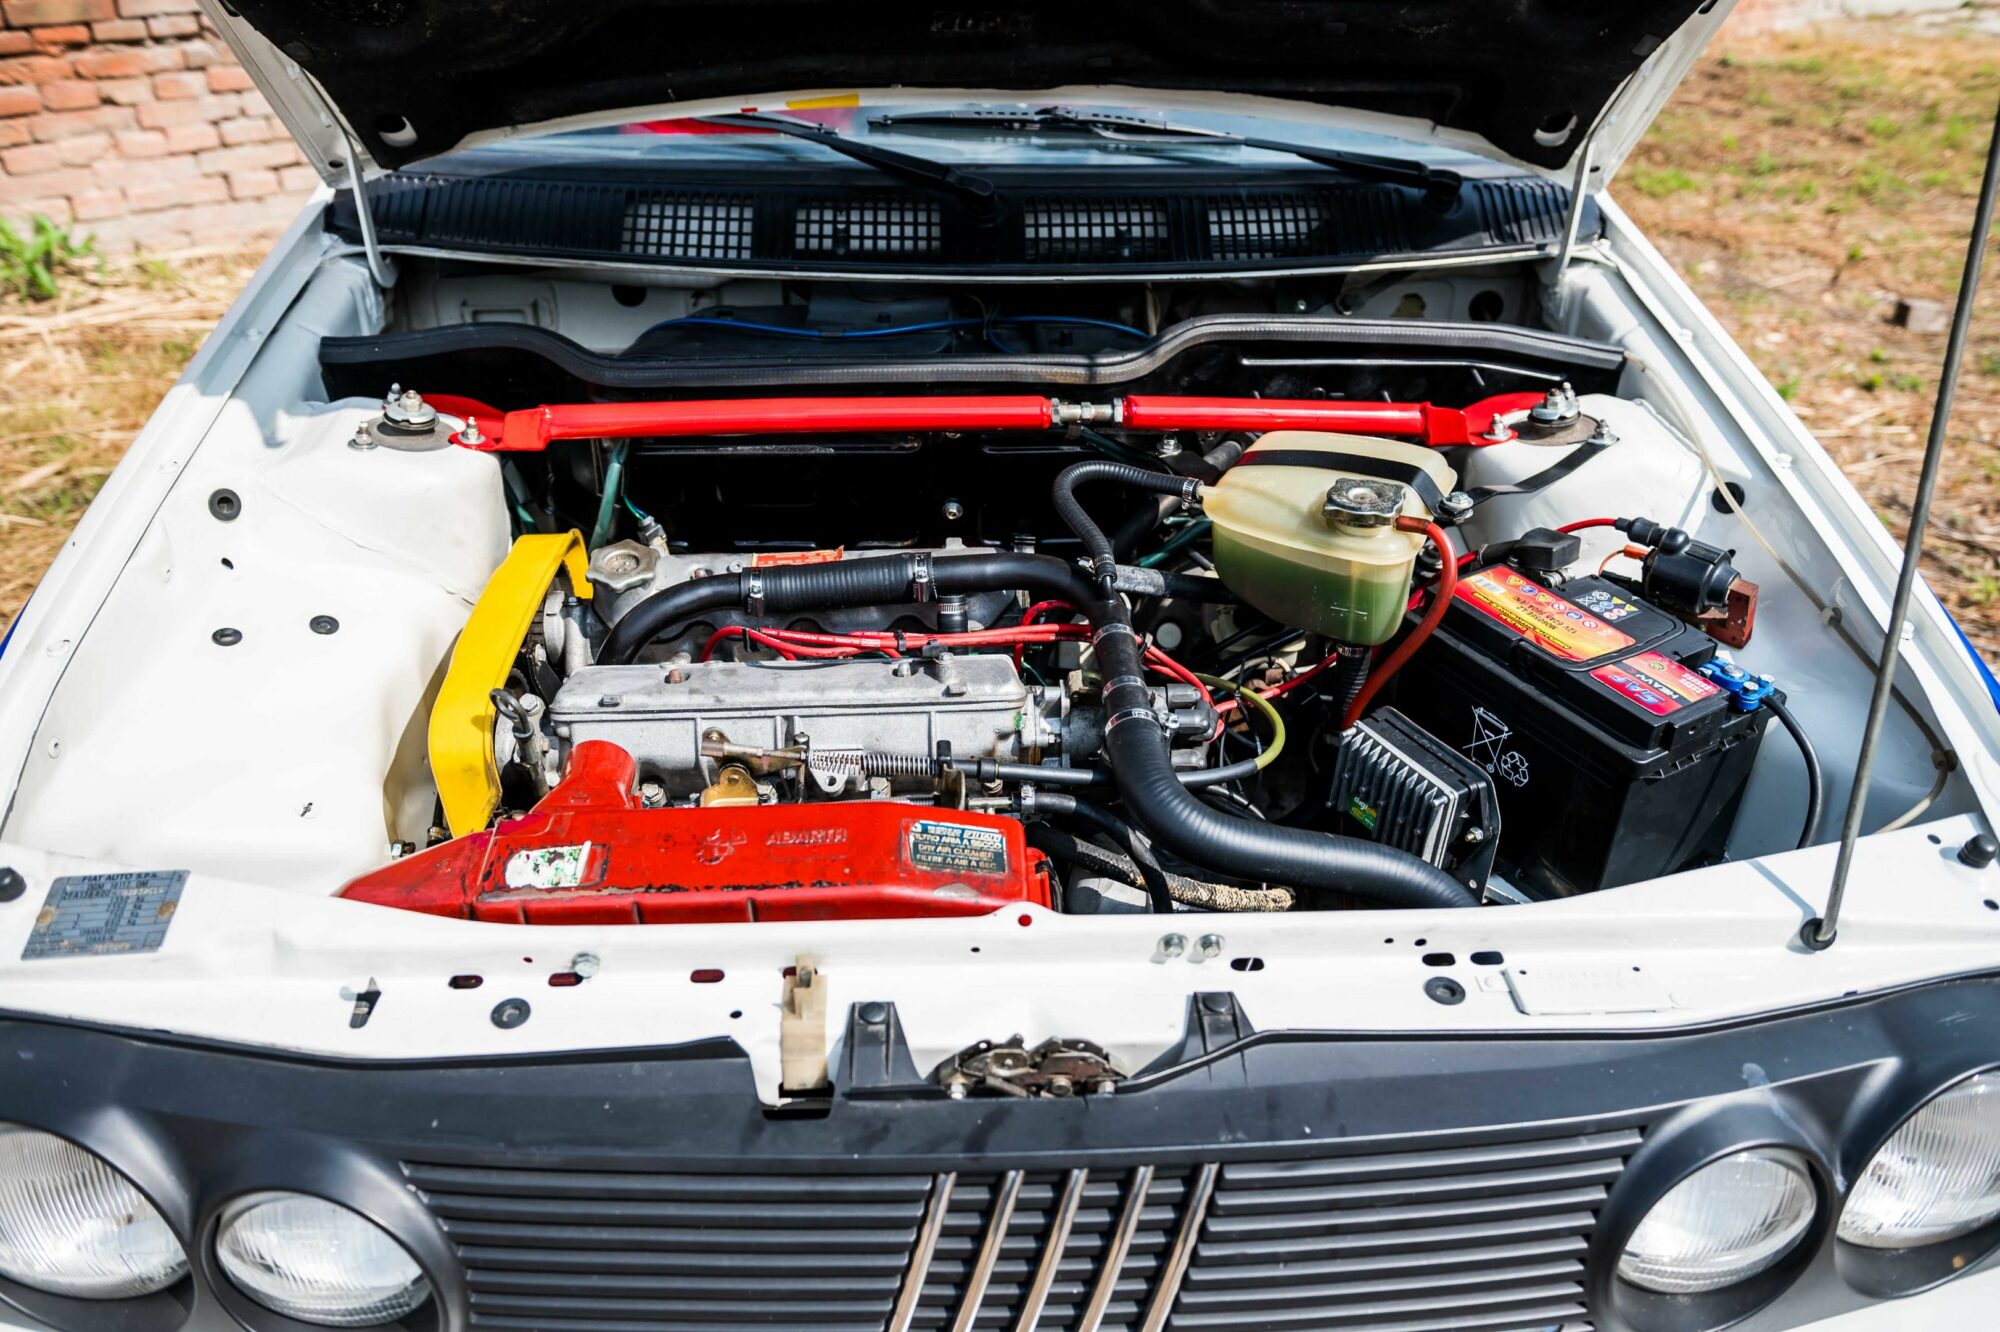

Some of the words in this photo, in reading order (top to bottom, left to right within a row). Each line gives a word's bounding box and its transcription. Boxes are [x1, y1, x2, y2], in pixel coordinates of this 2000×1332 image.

[1635, 673, 1680, 699] HEAVY
[766, 828, 848, 845] ABARTH
[918, 843, 935, 853] DRY
[937, 845, 951, 854] AIR
[953, 847, 995, 859] CLEANER
[82, 874, 105, 882] FIAT
[105, 873, 133, 881] AUTO
